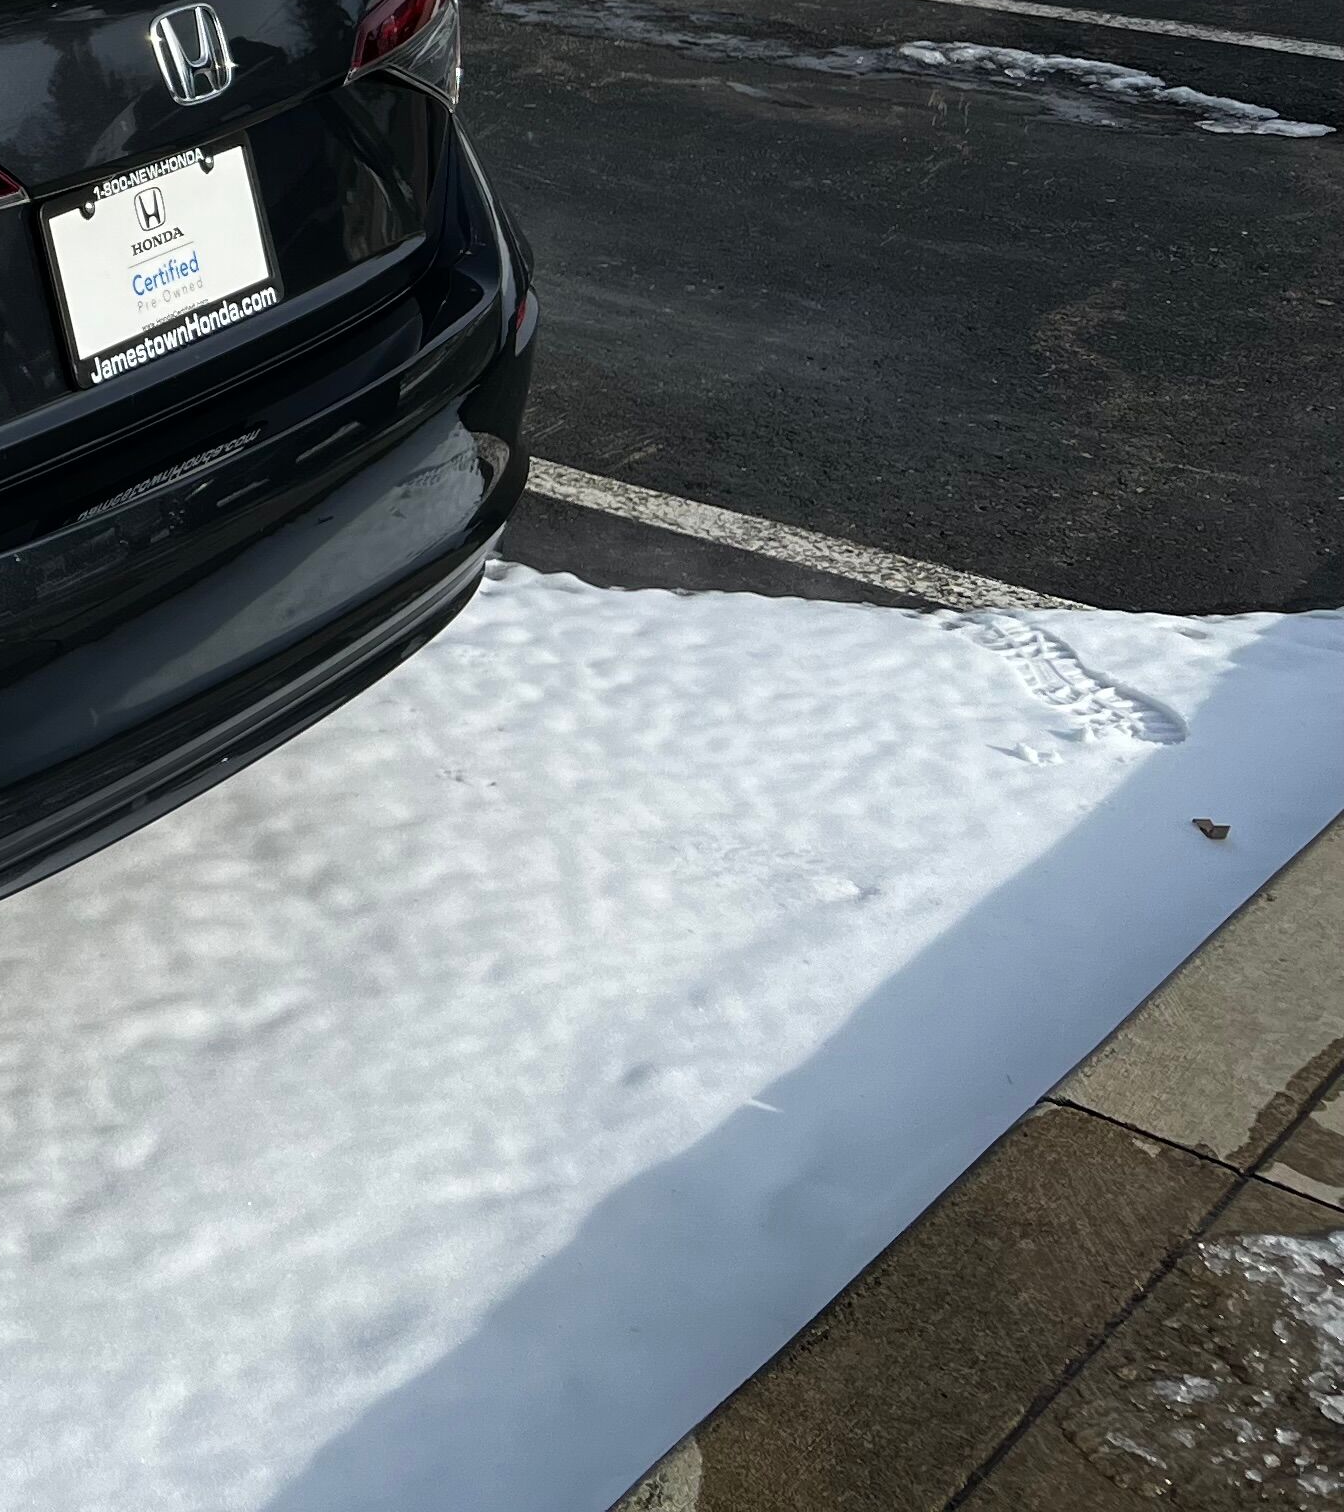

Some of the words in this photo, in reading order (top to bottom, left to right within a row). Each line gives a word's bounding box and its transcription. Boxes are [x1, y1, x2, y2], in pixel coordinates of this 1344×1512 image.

[93, 148, 205, 201] 1-800-NEW-HONDA
[131, 227, 184, 257] HONDA
[132, 251, 200, 296] Certified
[91, 287, 277, 384] JamestownHonda.com
